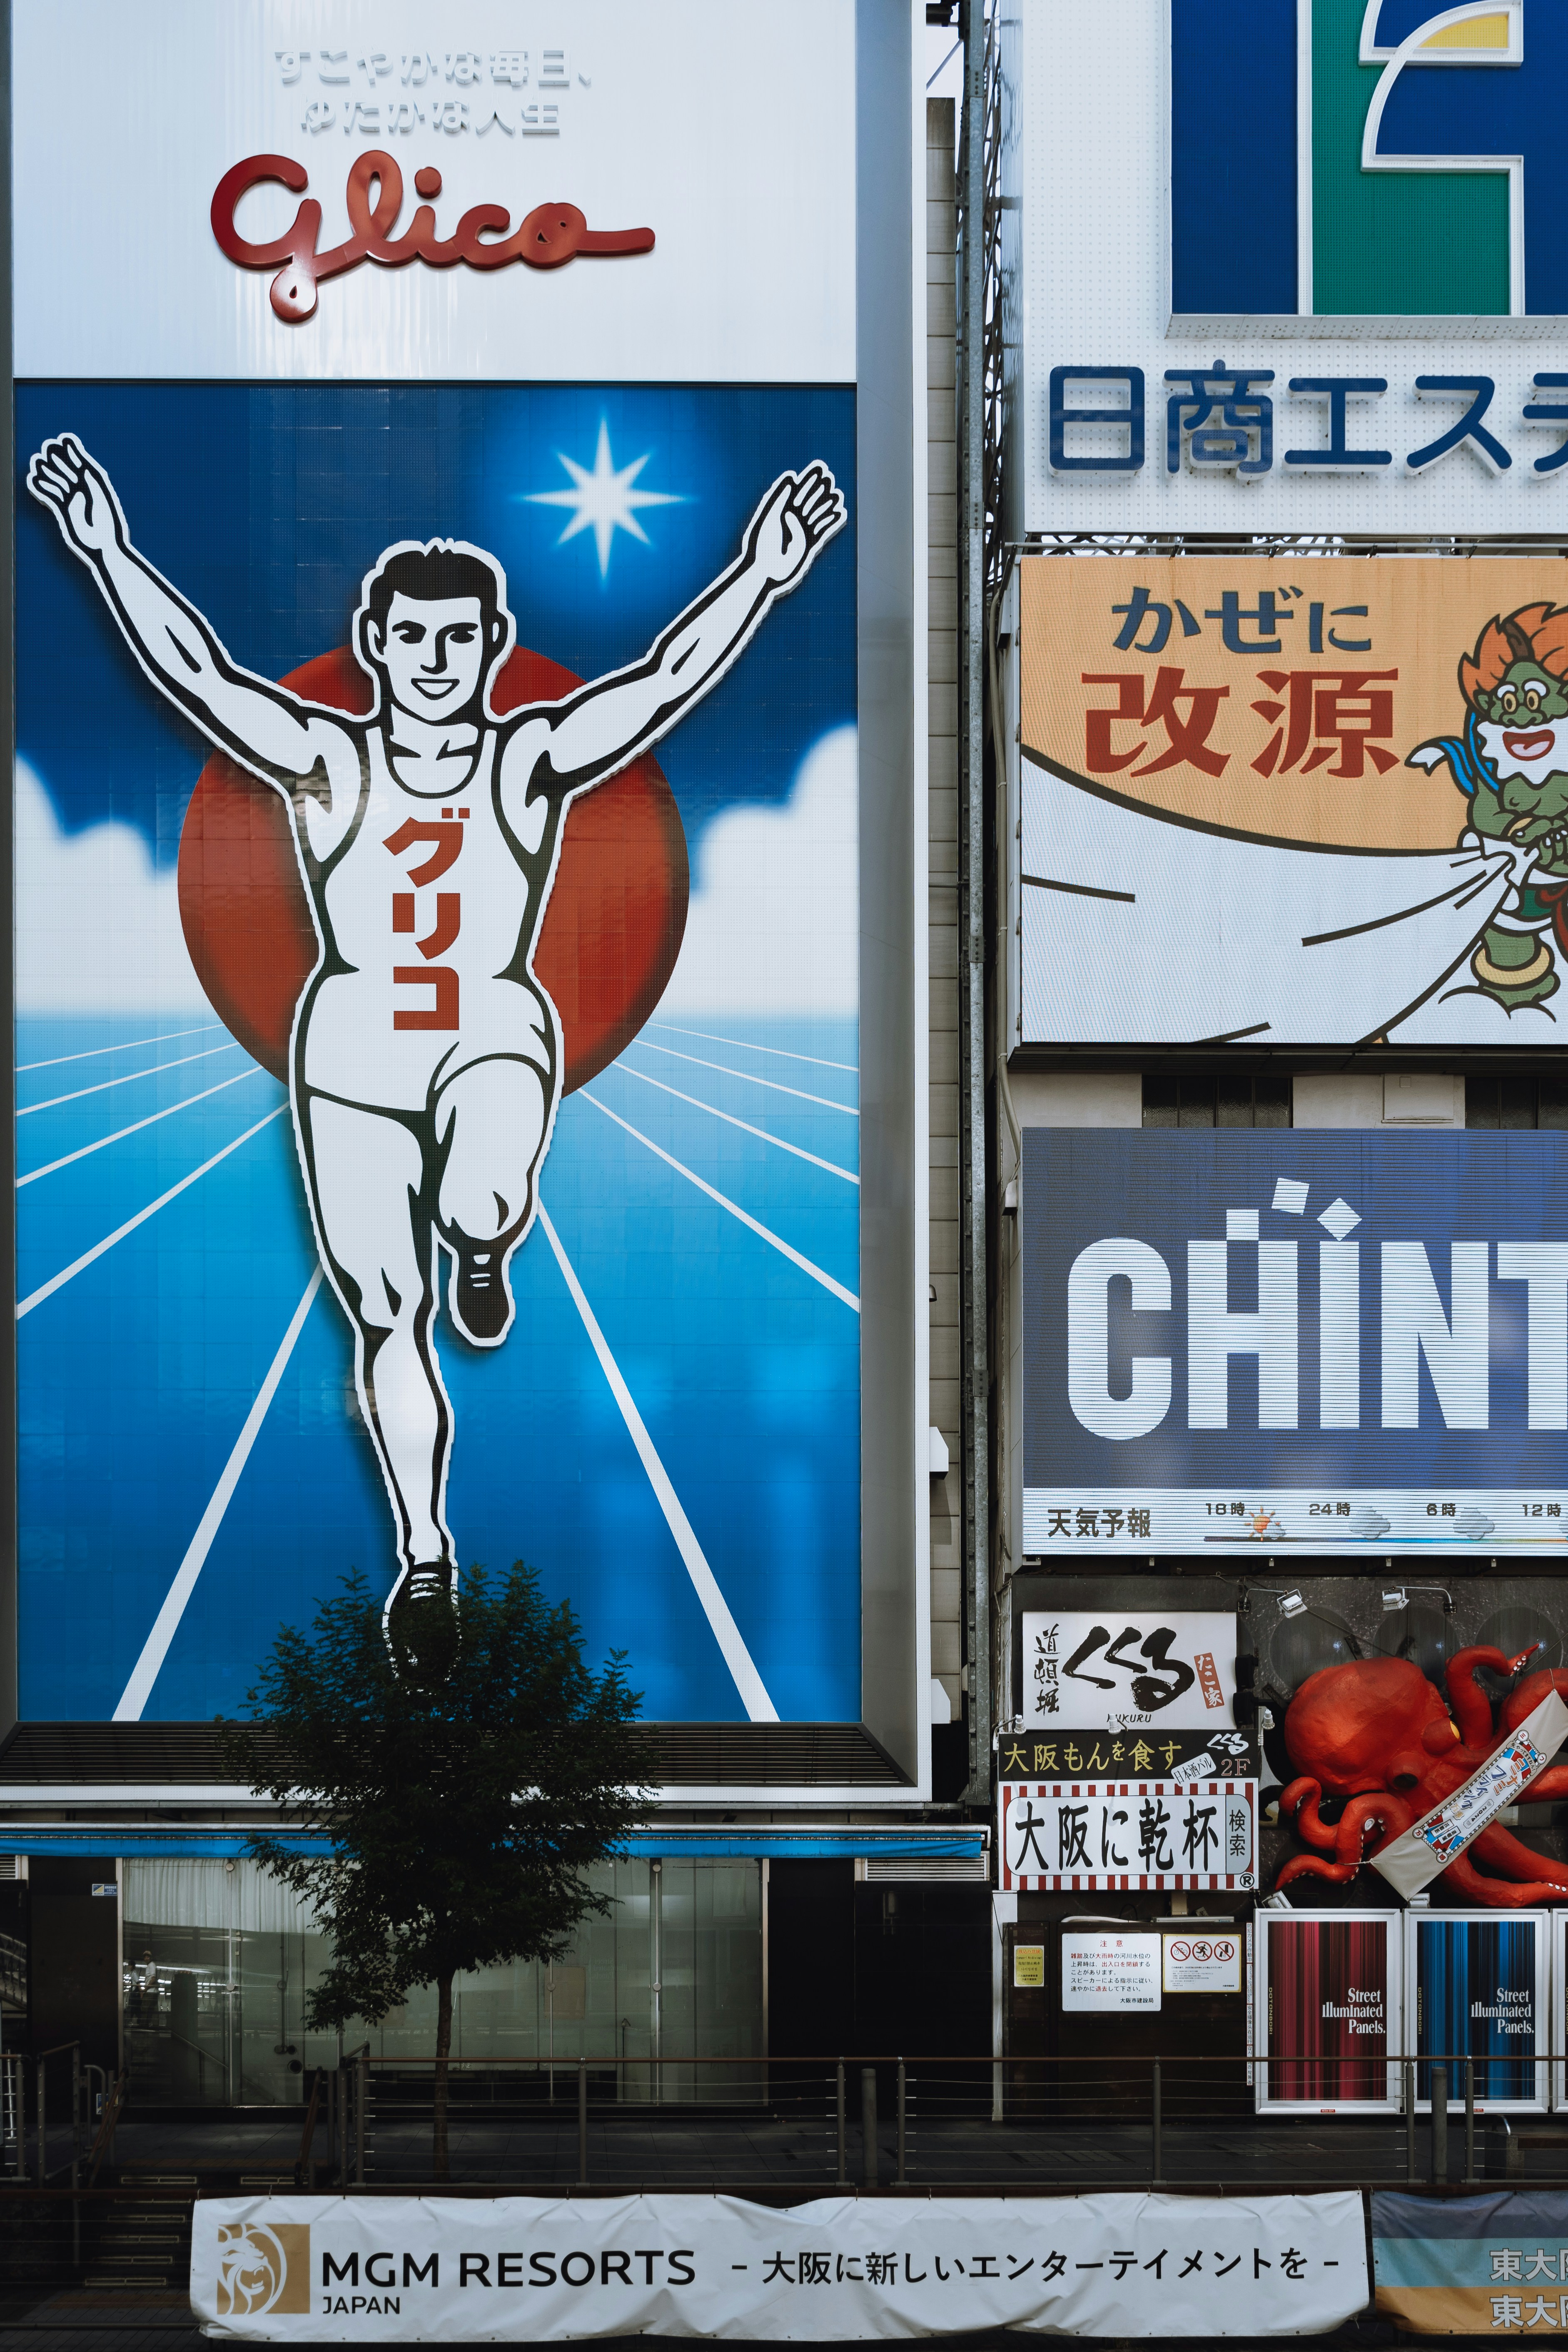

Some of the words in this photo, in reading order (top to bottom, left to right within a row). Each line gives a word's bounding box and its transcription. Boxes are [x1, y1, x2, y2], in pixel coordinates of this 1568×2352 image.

[274, 46, 591, 87] すこやかな毎日、
[300, 95, 561, 135] ゆたかな人生
[210, 150, 656, 323] Glico
[1112, 586, 1371, 653] かぜに
[1082, 666, 1400, 778] 改源
[382, 808, 470, 1030] グリコ
[1047, 1507, 1151, 1538] 天気予報
[1206, 1502, 1245, 1517] 18時
[1309, 1502, 1350, 1517] 24時
[1426, 1503, 1456, 1517] 6時
[1522, 1503, 1561, 1517] 12時
[1034, 1623, 1062, 1716] 道頓堀
[1004, 1739, 1182, 1772] 大阪もんを食す
[1174, 1756, 1212, 1785] 日本酒バル
[1221, 1759, 1250, 1776] 2F
[1493, 1758, 1525, 1795] ミナミ
[1471, 1806, 1487, 1821] 2024
[1015, 1798, 1219, 1872] 大阪に乾杯
[1229, 1809, 1246, 1856] 検索
[1348, 1988, 1381, 2003] Street
[1496, 1988, 1529, 2003] Street
[1349, 2019, 1386, 2034] Panels.
[1497, 2019, 1534, 2034] Panels.
[322, 2252, 439, 2288] MGM
[460, 2250, 696, 2287] RESORTS
[762, 2247, 1308, 2285] 大阪に新しいエンターテイメントを
[1489, 2248, 1568, 2281] 東大
[322, 2296, 401, 2315] JAPAN
[1489, 2294, 1568, 2327] 東大
